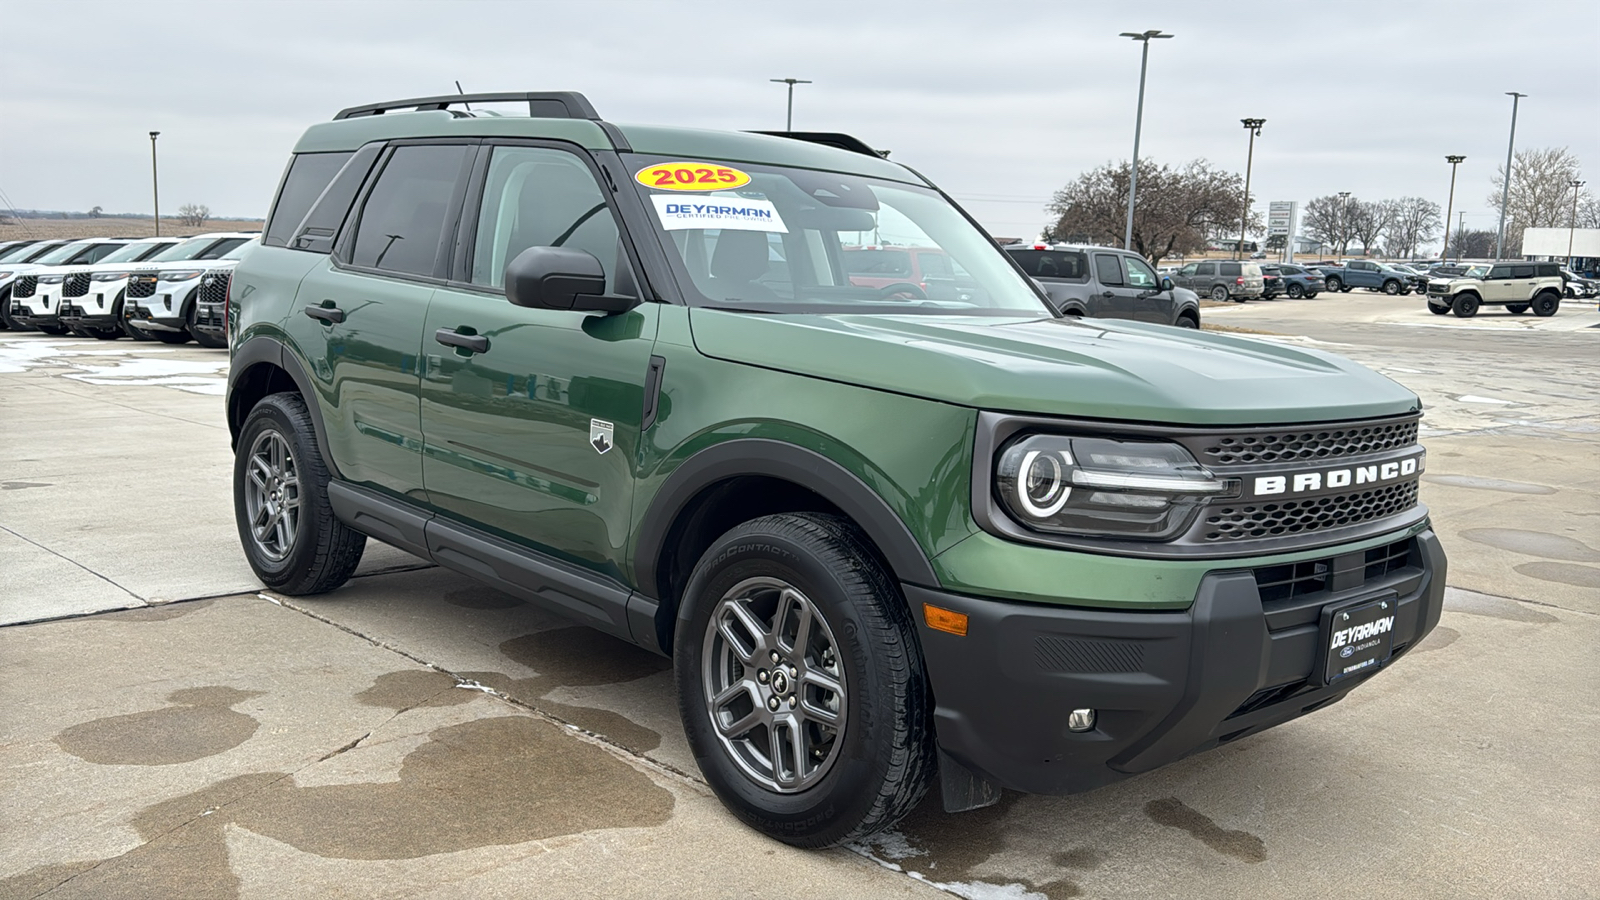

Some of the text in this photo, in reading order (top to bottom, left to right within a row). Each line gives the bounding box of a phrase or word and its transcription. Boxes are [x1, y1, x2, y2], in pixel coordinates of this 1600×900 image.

[652, 169, 737, 185] 2025
[666, 204, 772, 218] DEYARMAN
[1254, 457, 1416, 496] BRONCO
[1331, 615, 1395, 650] DEYARMAN
[1356, 638, 1380, 651] INDIANOLA
